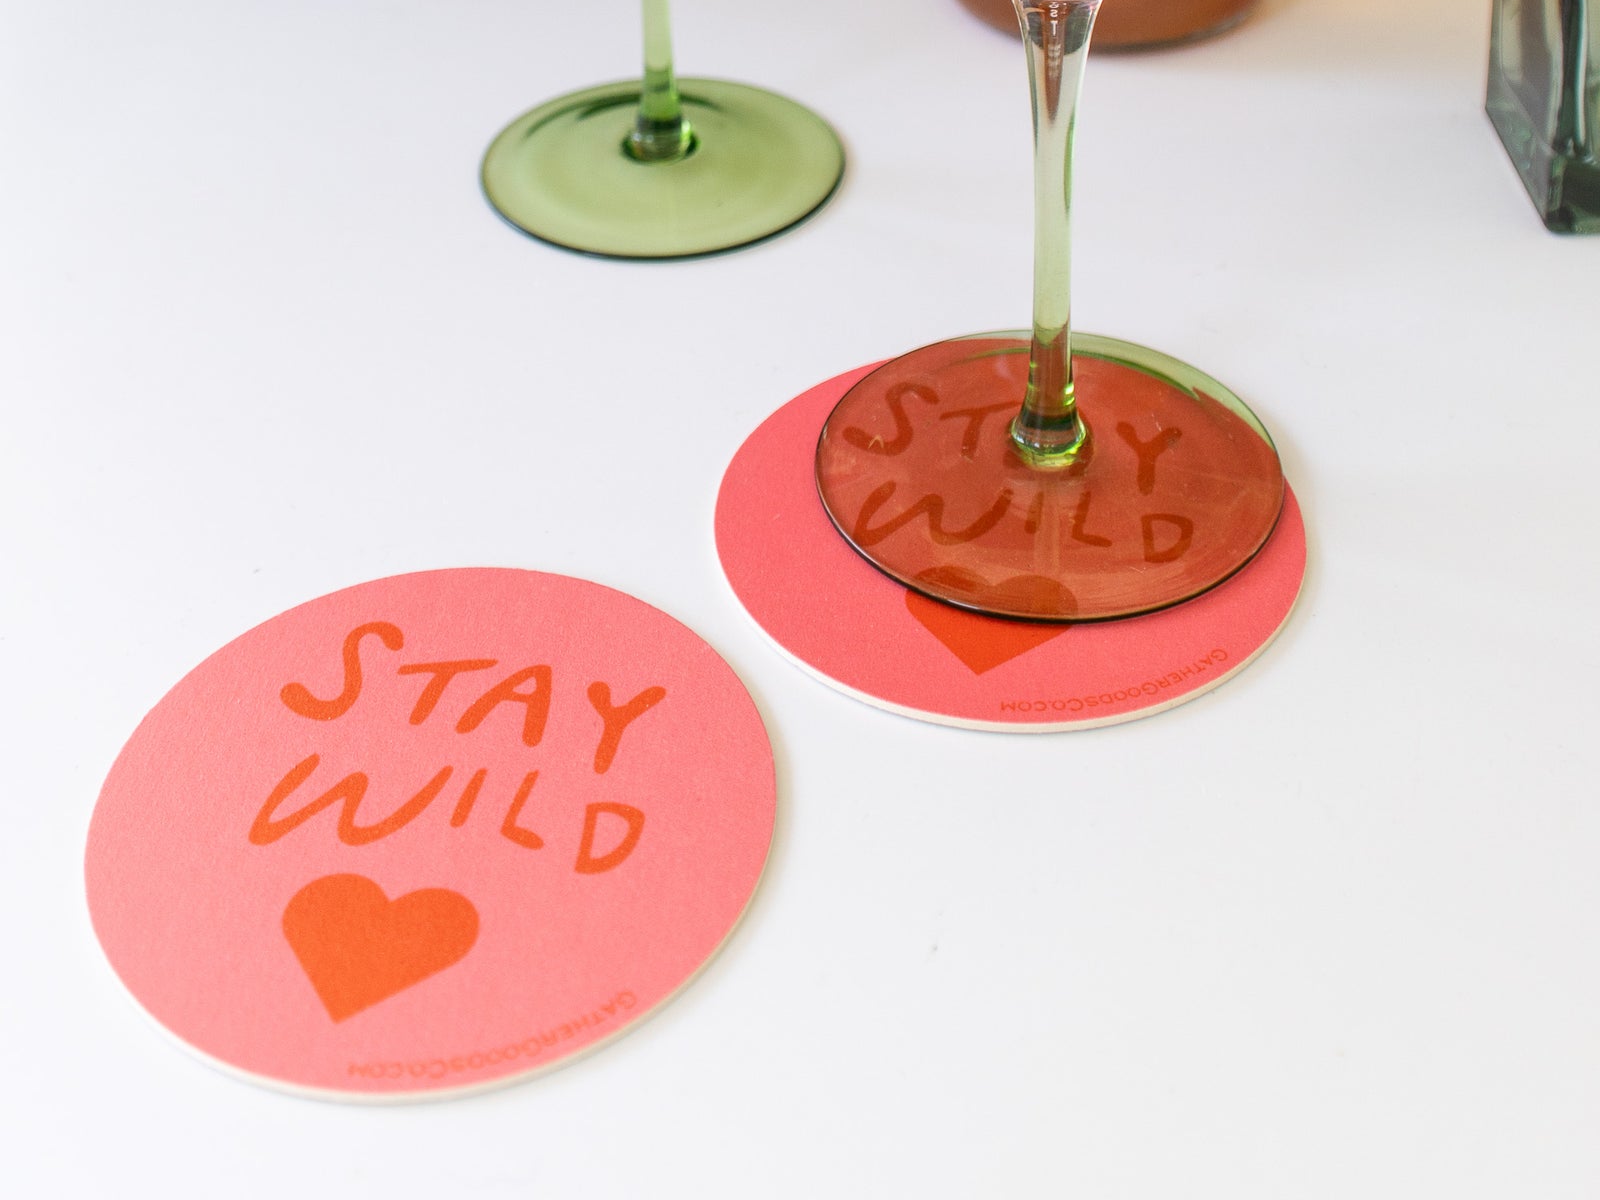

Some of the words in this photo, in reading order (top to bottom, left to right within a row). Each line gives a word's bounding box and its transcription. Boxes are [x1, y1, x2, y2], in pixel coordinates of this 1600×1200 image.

[842, 382, 1182, 496] STY
[852, 480, 1195, 564] WILD
[279, 621, 667, 775] STAY
[248, 753, 646, 875] WILD
